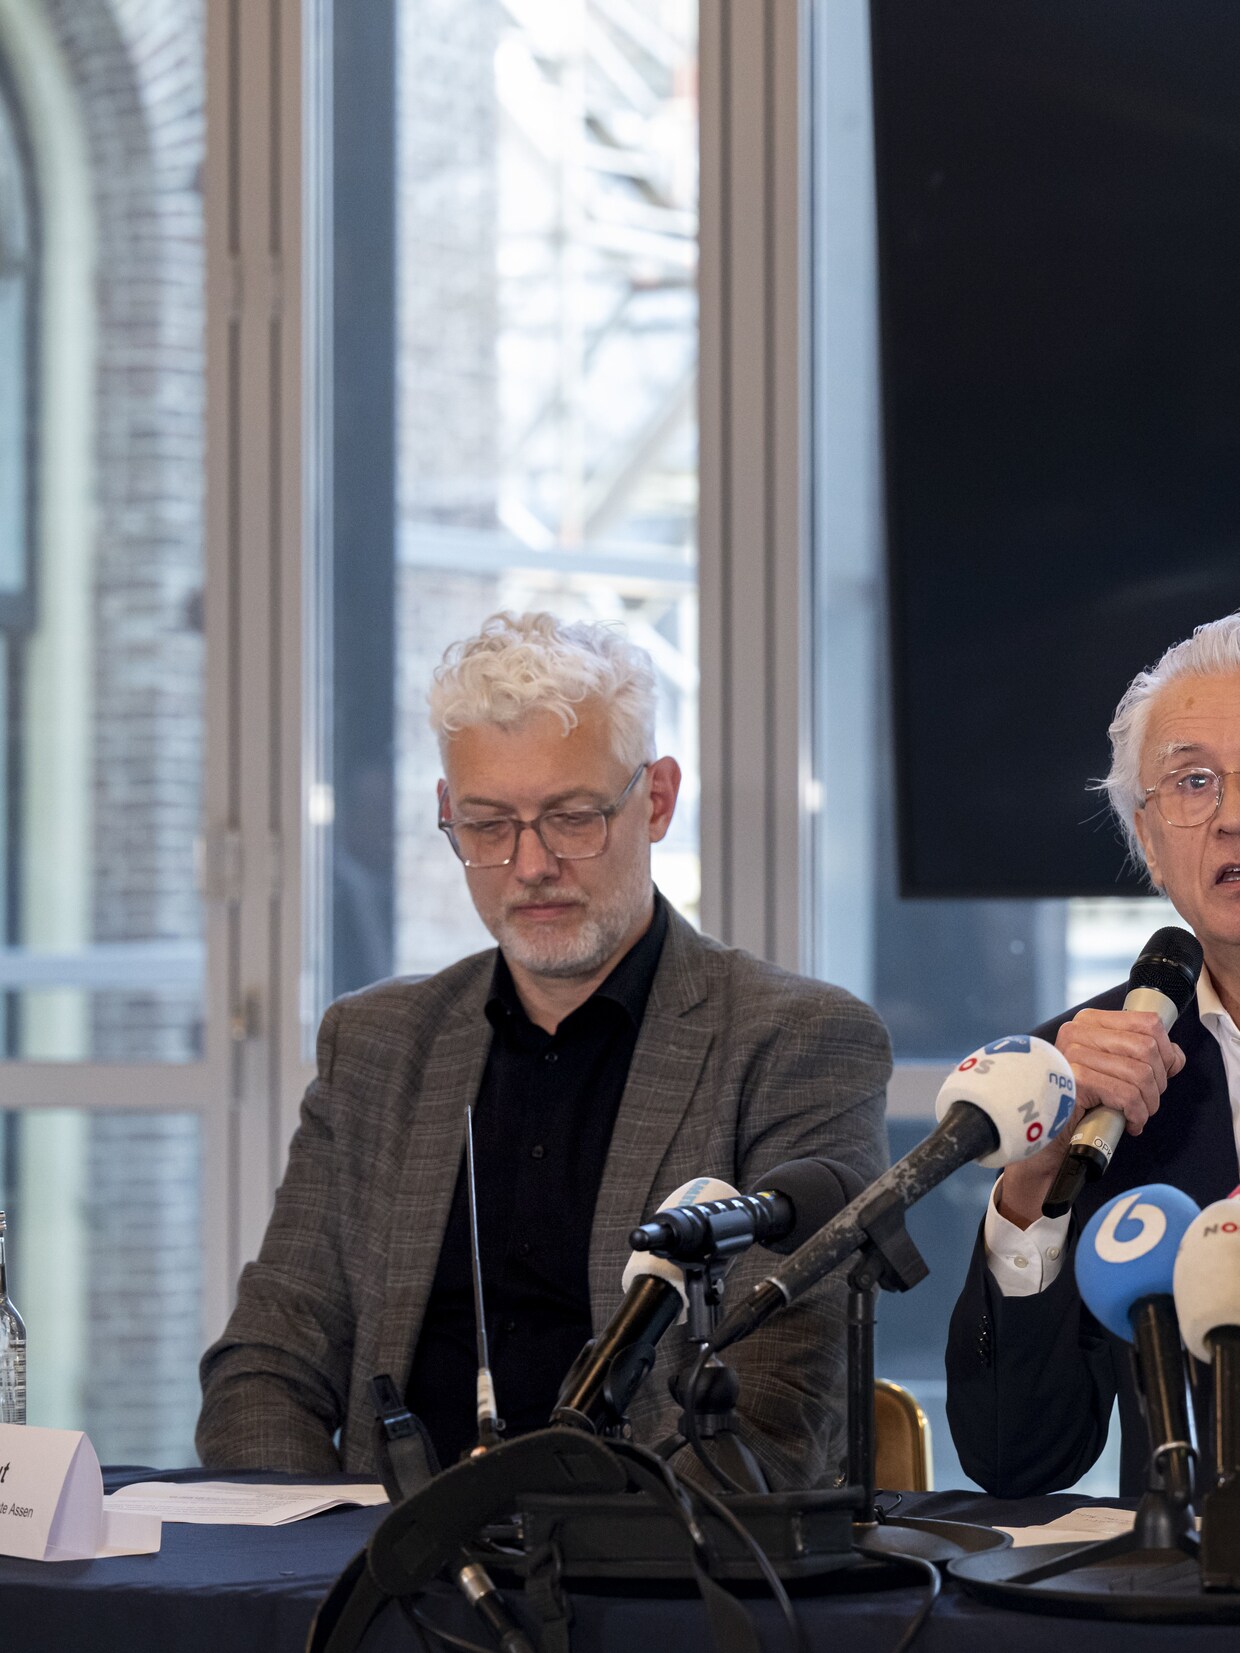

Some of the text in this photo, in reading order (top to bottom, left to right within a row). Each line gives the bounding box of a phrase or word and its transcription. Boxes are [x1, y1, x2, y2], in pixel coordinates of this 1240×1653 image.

[959, 1058, 995, 1074] OS
[1049, 1073, 1073, 1091] npo
[8, 1502, 34, 1518] Assen
